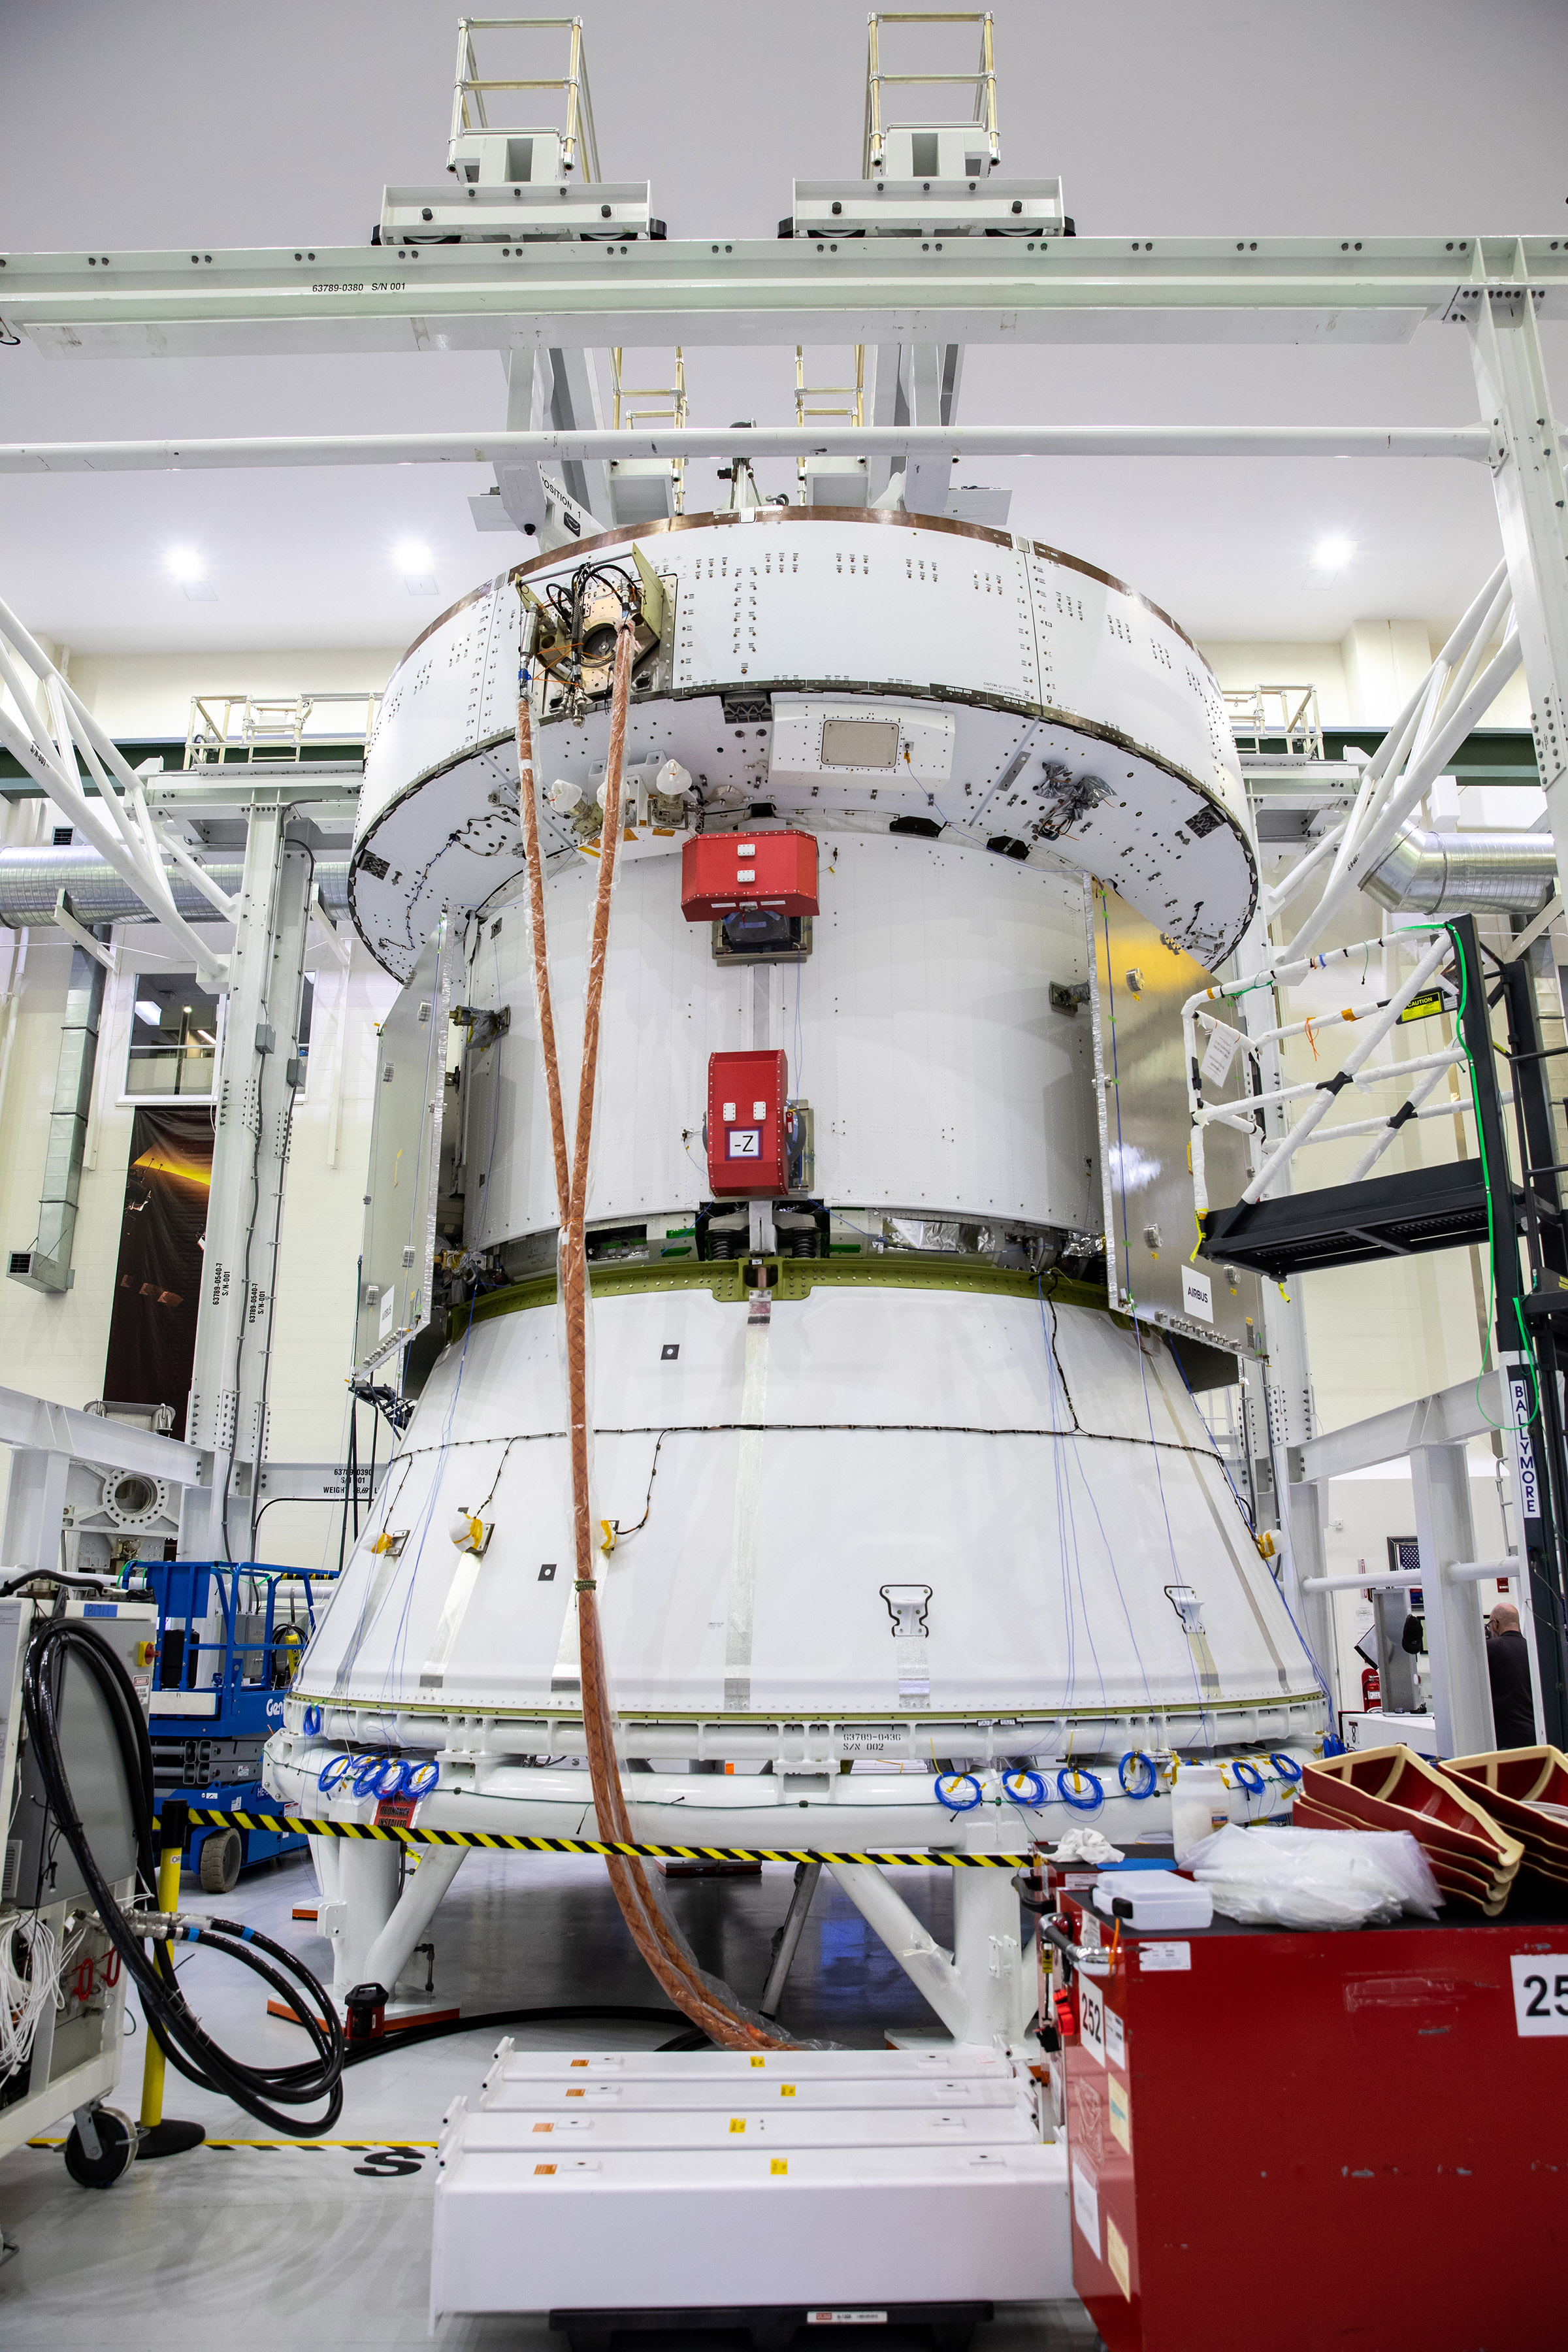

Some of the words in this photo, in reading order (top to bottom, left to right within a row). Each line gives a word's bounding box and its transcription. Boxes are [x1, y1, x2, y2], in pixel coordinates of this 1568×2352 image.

[312, 284, 364, 293] 63789-0380
[390, 282, 406, 291] 001
[542, 476, 572, 511] OSITION
[1407, 996, 1433, 1007] CAUTION
[734, 1135, 754, 1152] -Z
[212, 1262, 223, 1305] 63789-0540-7
[221, 1271, 231, 1296] S/N-001
[1187, 1286, 1208, 1303] AIRBUS
[249, 1283, 258, 1323] 63789-0540-7
[1514, 1386, 1536, 1512] BALLYMORE
[378, 1817, 408, 1828] INSTALLED
[1082, 1992, 1102, 2044] 252
[353, 2151, 426, 2176] S
